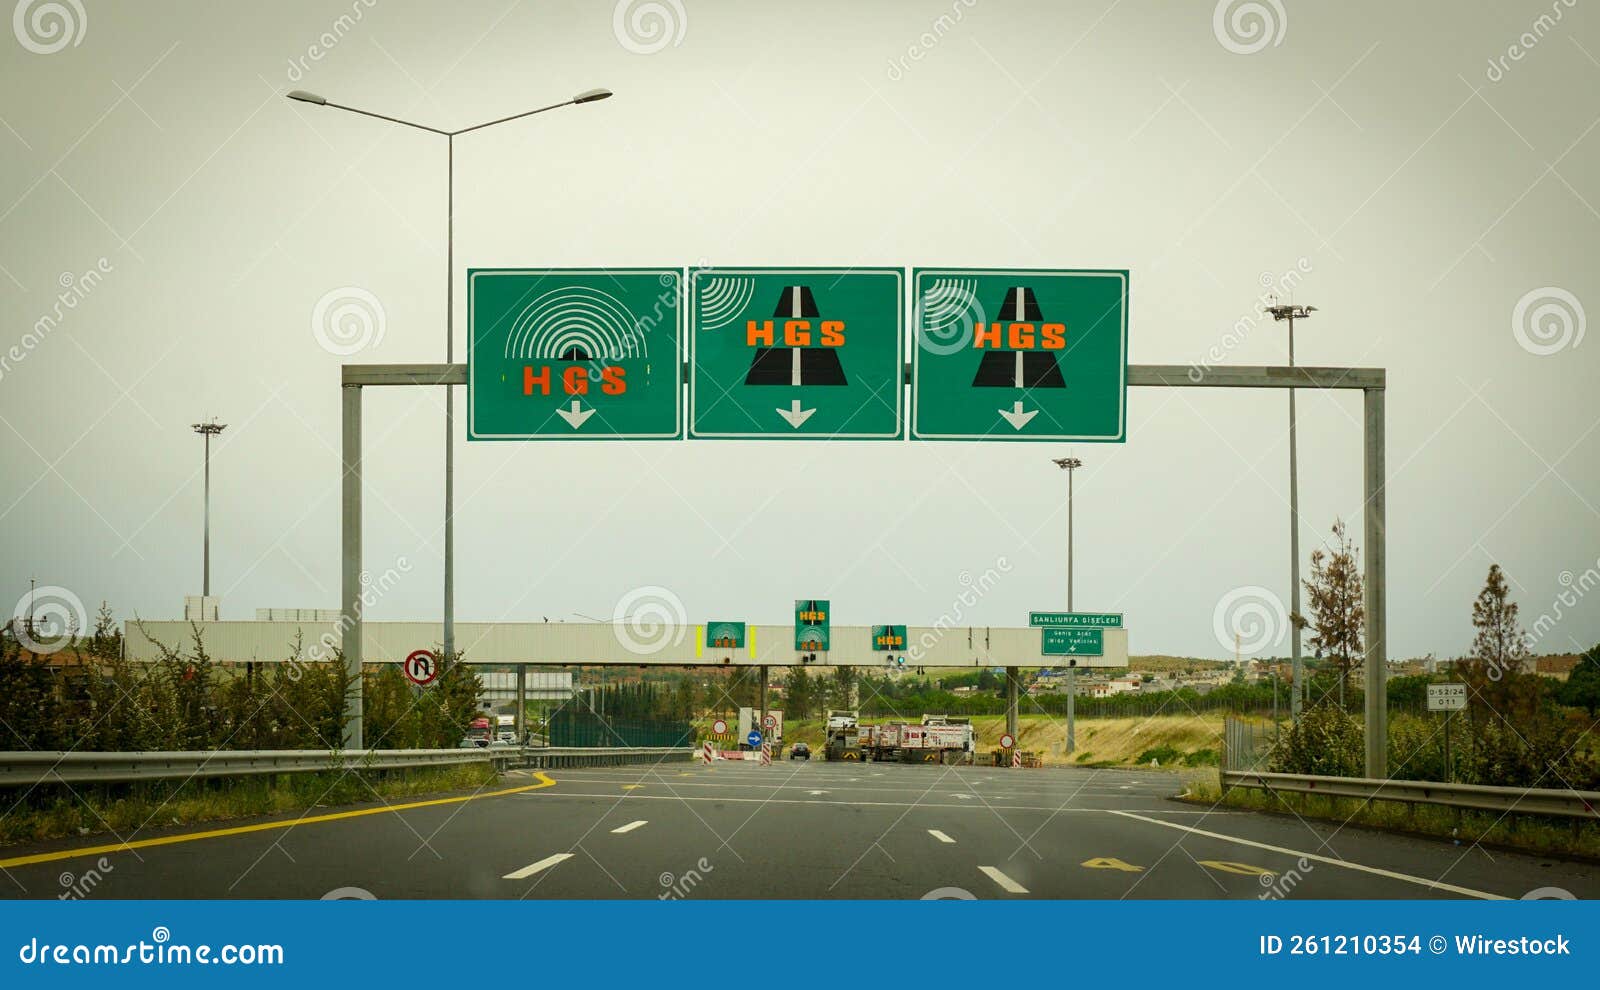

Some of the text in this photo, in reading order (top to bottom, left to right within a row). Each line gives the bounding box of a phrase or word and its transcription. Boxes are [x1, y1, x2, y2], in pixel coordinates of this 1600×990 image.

[746, 320, 846, 347] HGS
[974, 322, 1066, 350] HGS
[523, 366, 627, 396] HGS
[800, 611, 824, 621] HGS
[877, 636, 902, 646] HGS
